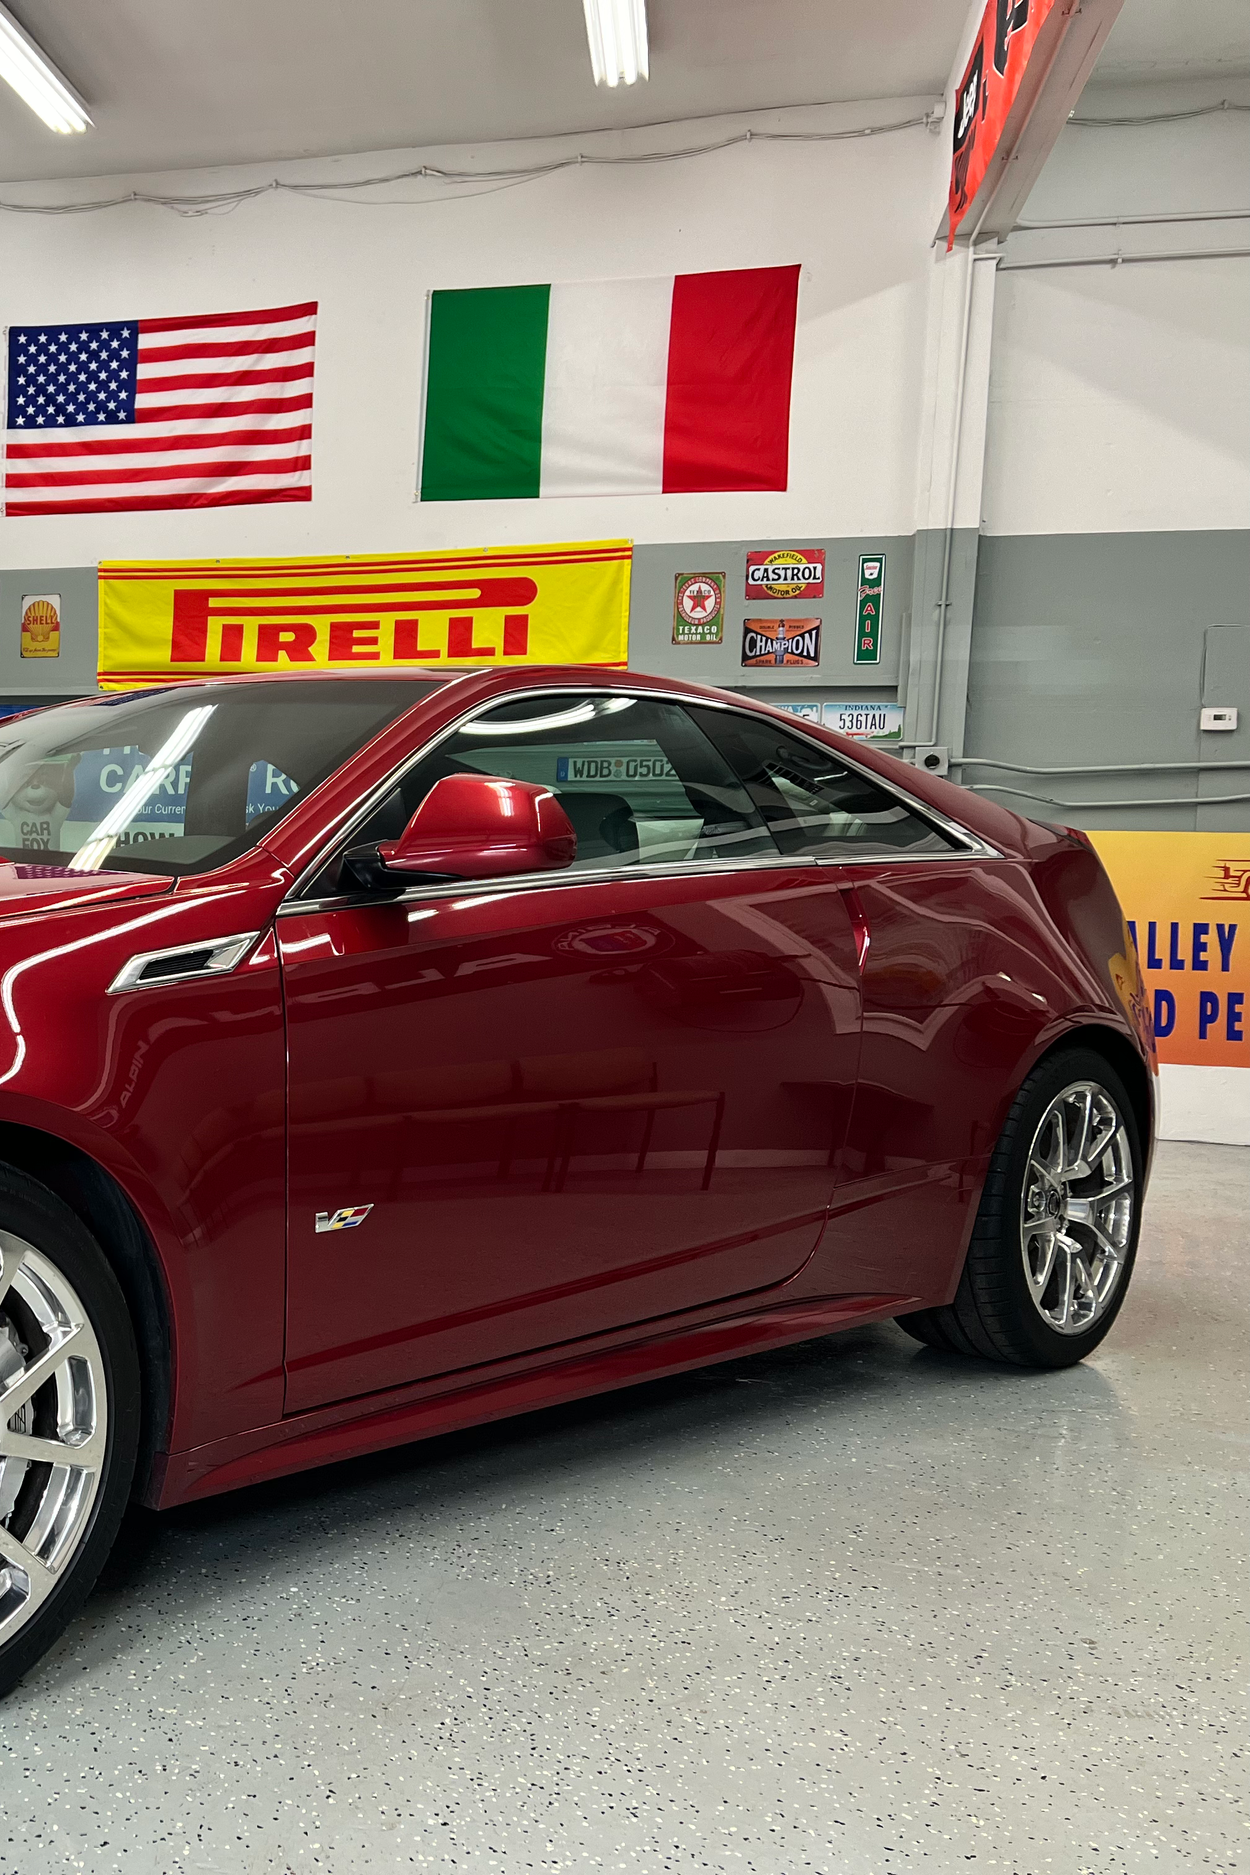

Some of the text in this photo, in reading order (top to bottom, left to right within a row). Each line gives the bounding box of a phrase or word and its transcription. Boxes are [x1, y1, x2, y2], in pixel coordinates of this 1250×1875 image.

[768, 553, 803, 564] WAKEFIELD
[751, 566, 820, 582] CASTROL
[27, 615, 55, 625] SHELL
[170, 576, 538, 663] PIRELLI
[861, 602, 875, 650] AIR
[678, 625, 717, 634] TEXACO
[745, 629, 817, 657] CHAMPION
[839, 713, 886, 730] 536TAU
[573, 760, 612, 778] WDB
[20, 821, 51, 836] CAR
